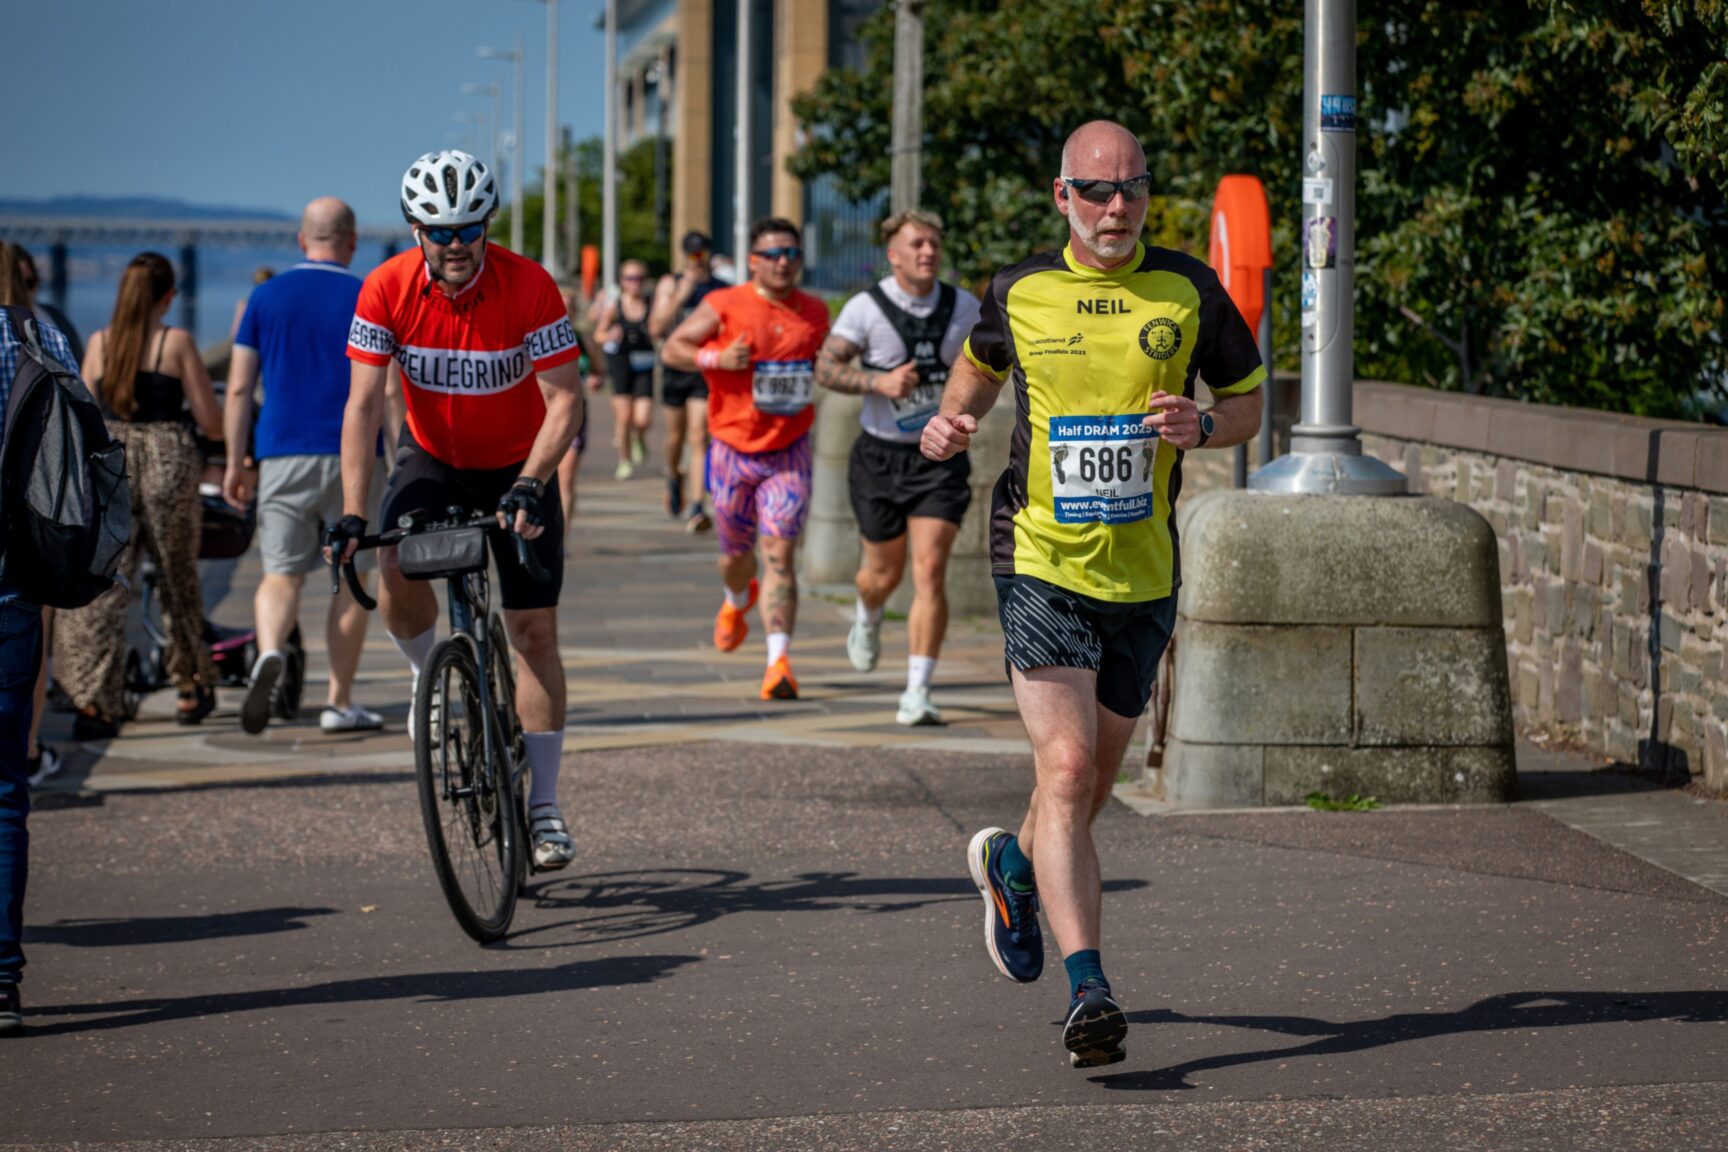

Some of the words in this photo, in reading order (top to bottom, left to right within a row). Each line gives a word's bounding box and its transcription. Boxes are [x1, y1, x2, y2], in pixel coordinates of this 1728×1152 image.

[1077, 299, 1132, 314] NEIL
[1143, 318, 1178, 331] FENWICK
[1058, 425, 1082, 436] Half
[1084, 425, 1119, 436] DRAM
[1080, 446, 1132, 483] 686
[1095, 488, 1119, 498] NEIL
